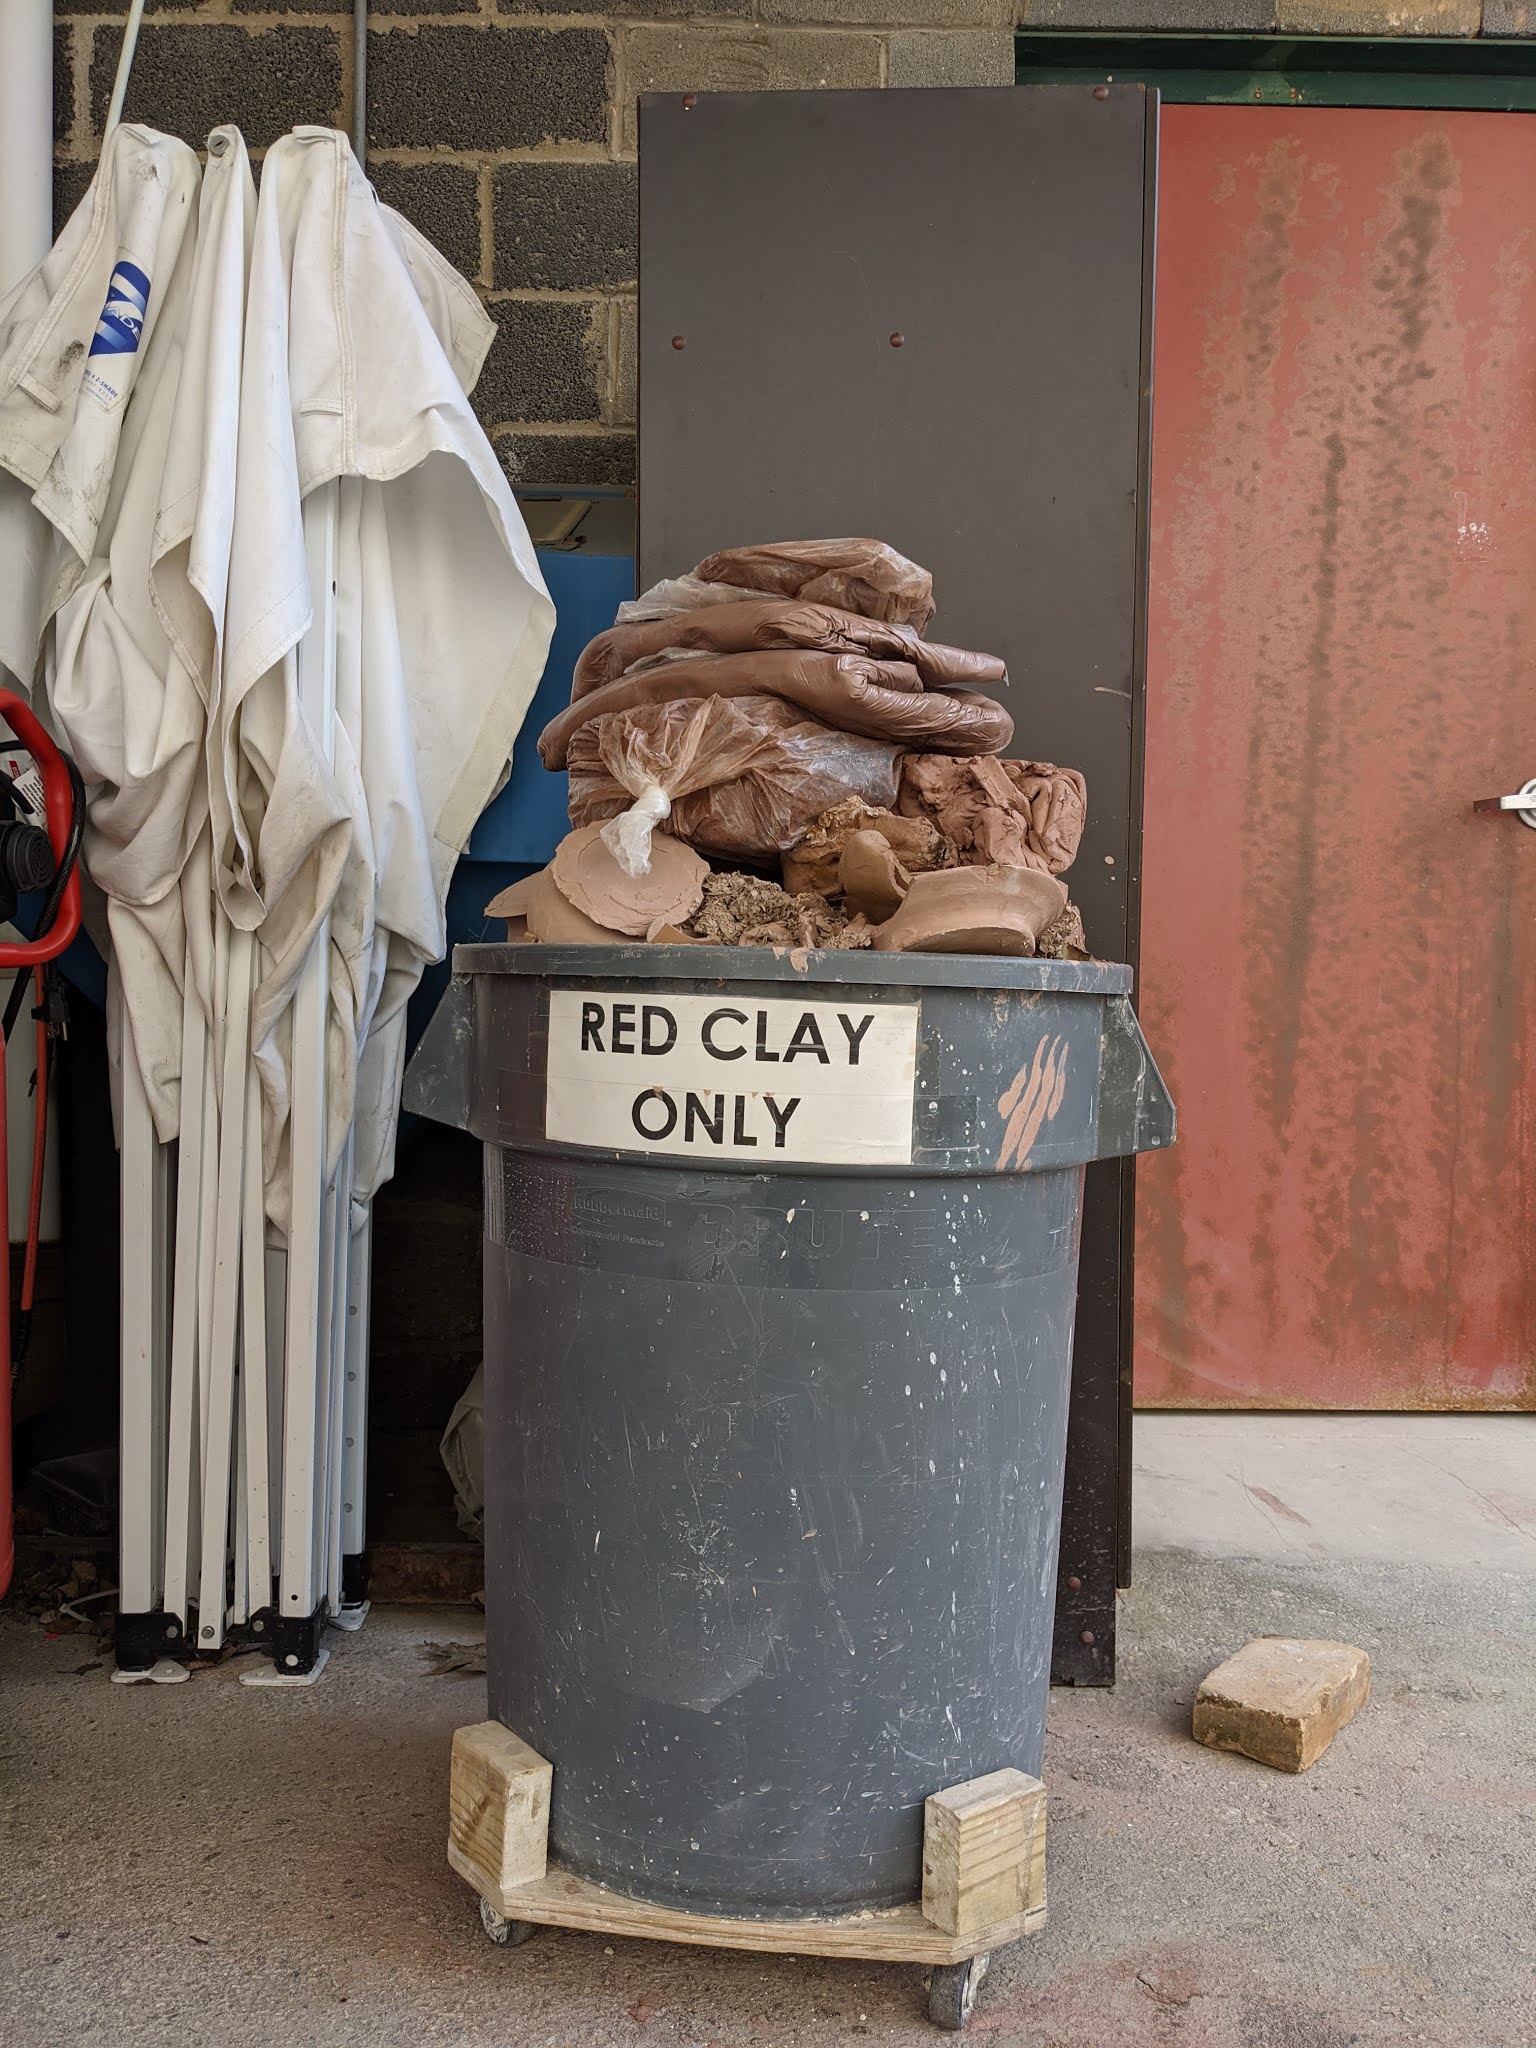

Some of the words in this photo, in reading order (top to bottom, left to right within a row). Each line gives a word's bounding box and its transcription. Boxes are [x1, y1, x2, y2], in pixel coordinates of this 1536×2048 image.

[581, 1001, 678, 1056] RED
[701, 1007, 876, 1066] CLAY
[631, 1087, 802, 1148] ONLY
